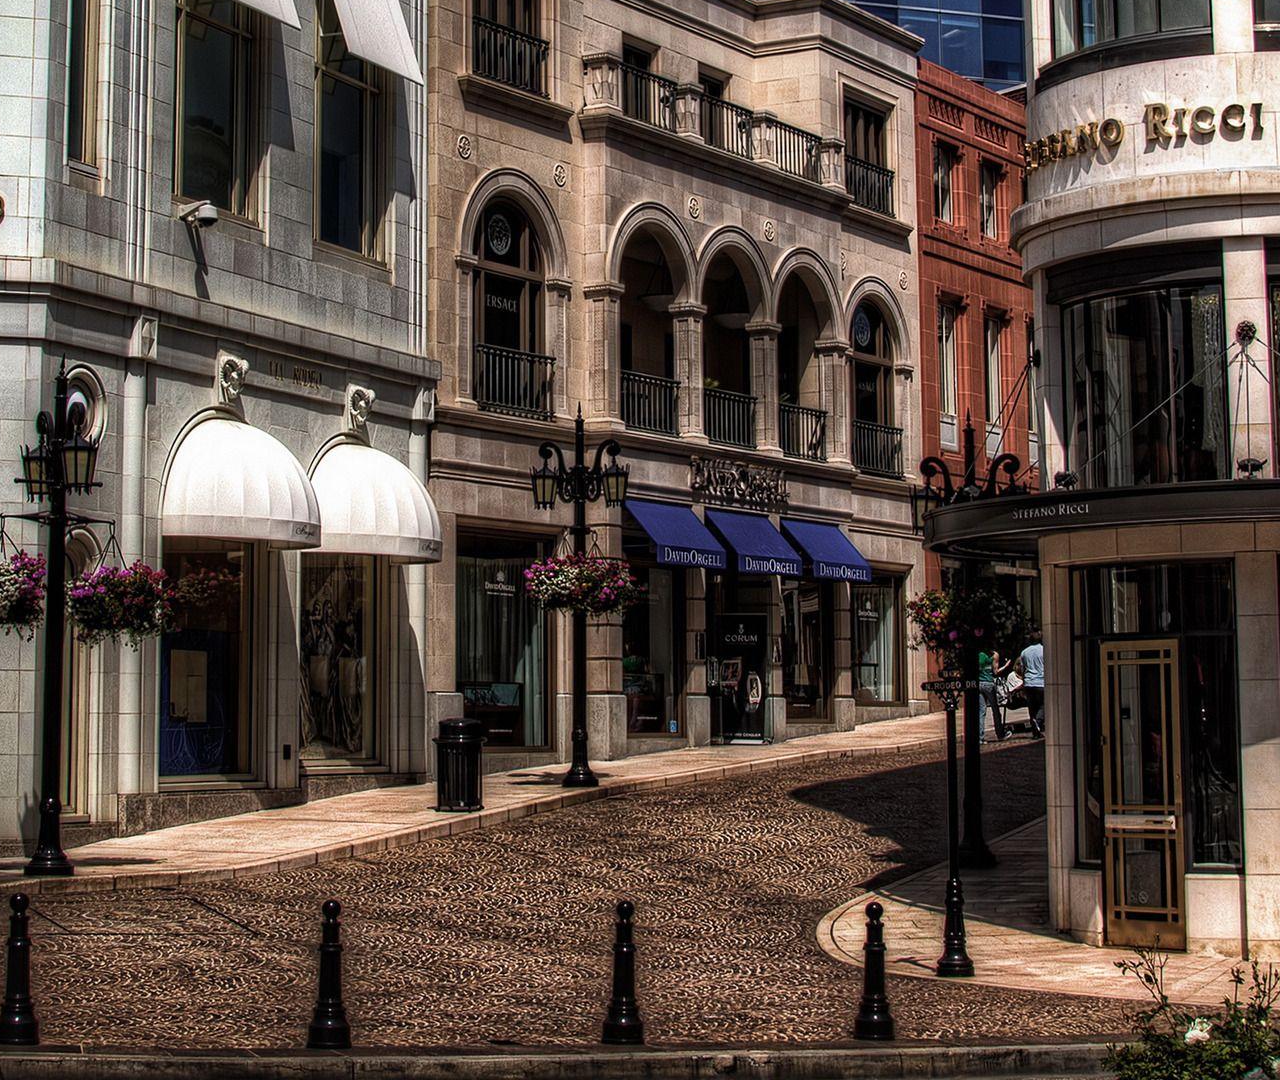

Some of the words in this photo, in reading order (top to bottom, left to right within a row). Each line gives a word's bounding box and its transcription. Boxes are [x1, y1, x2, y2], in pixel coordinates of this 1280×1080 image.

[1143, 102, 1263, 142] RICCI
[1012, 506, 1056, 519] STEFANO
[1058, 503, 1089, 516] RICCI
[725, 634, 758, 642] CORUM
[965, 680, 977, 689] DR
